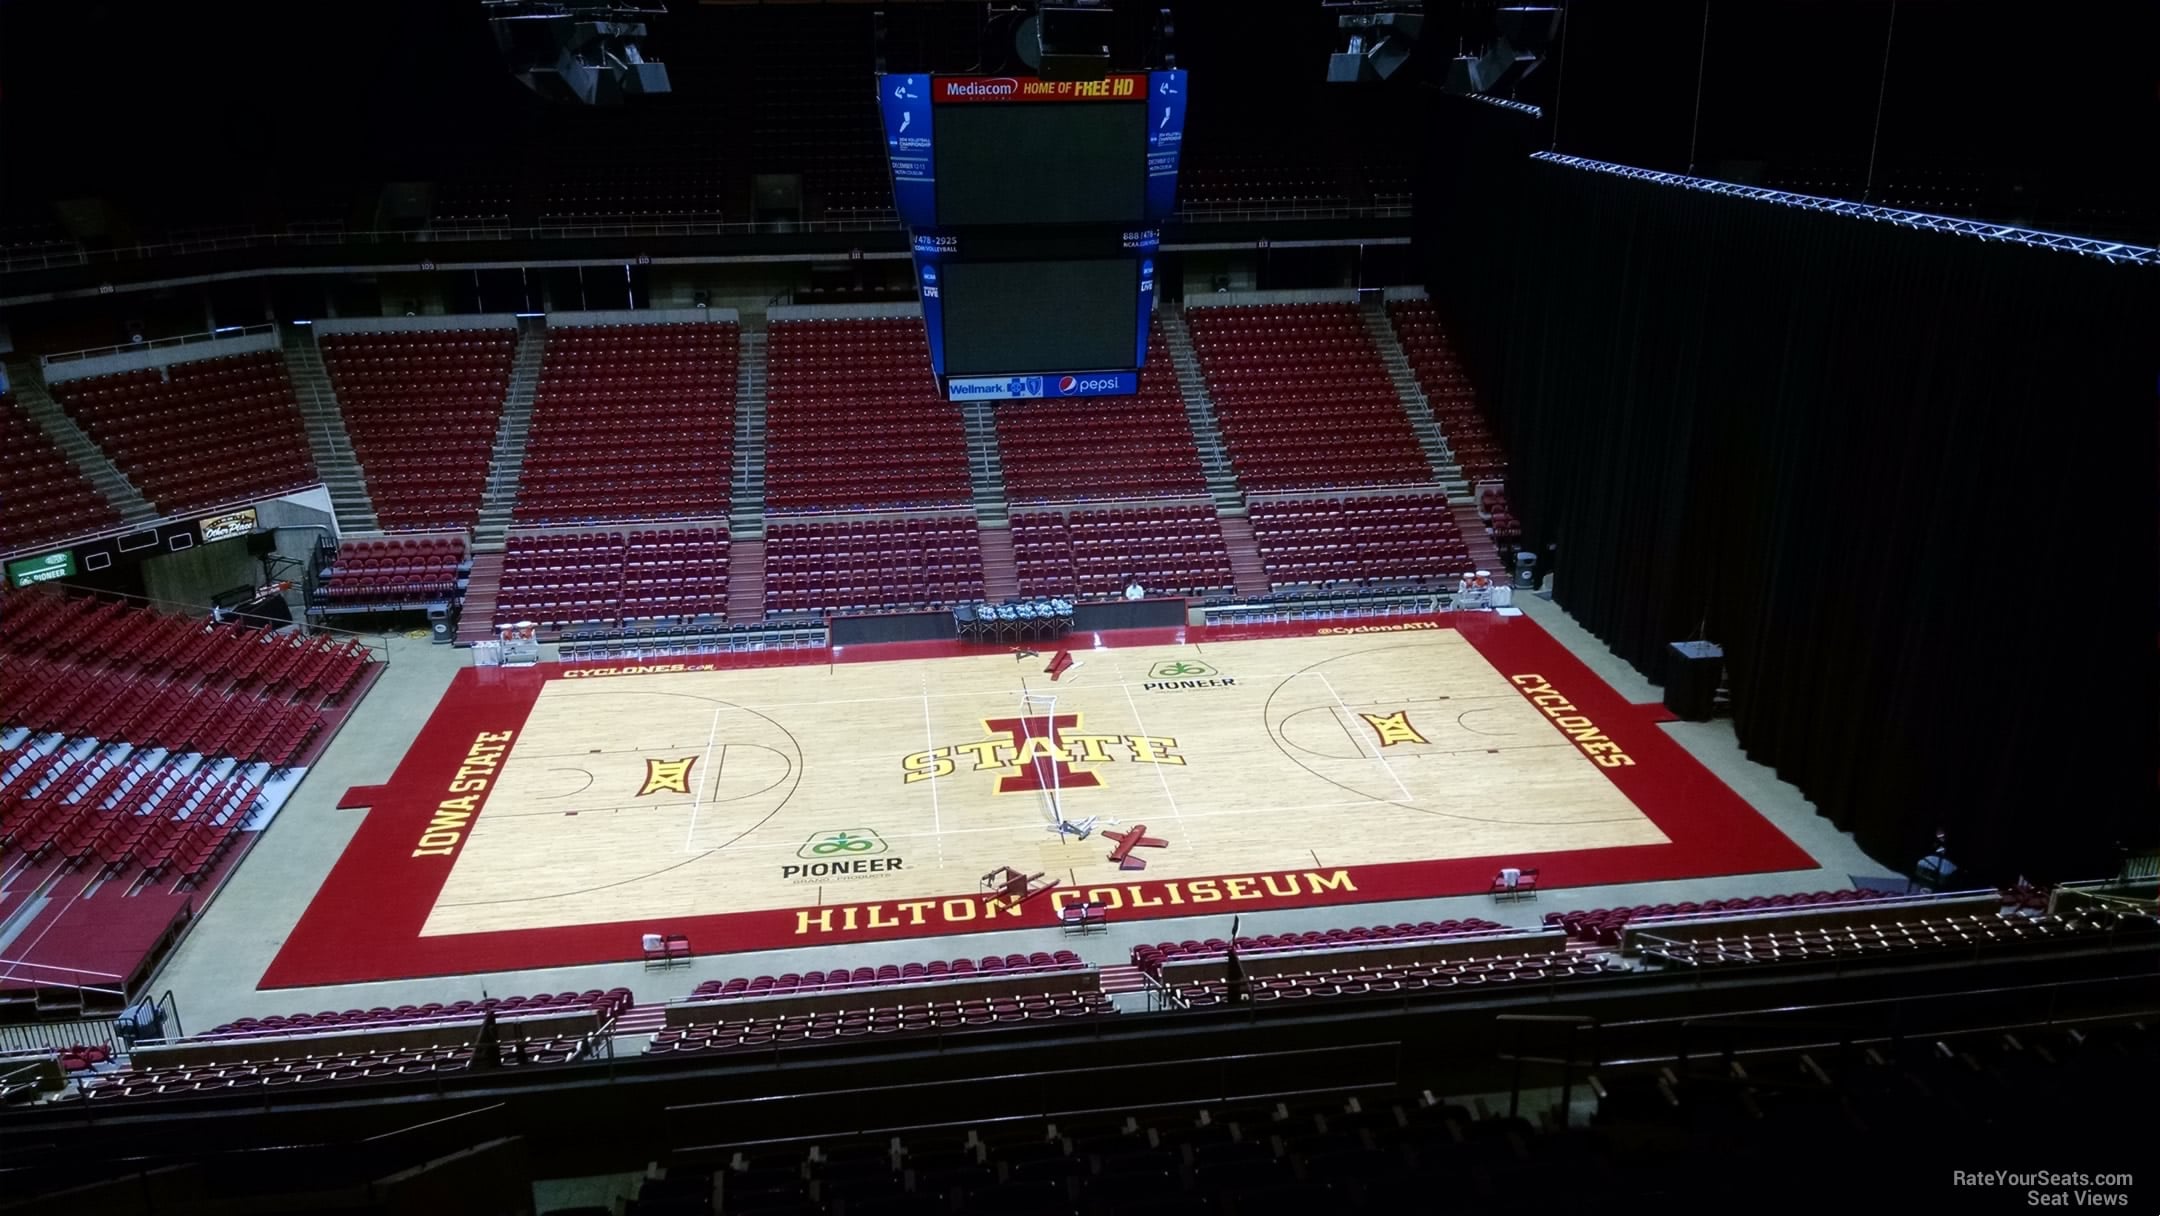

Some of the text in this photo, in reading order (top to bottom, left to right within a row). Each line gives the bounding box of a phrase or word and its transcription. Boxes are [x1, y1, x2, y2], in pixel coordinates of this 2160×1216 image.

[947, 82, 1012, 96] Mediacom
[1023, 78, 1134, 97] HOME OF FREE HD
[950, 383, 1003, 396] Wellmark
[1080, 377, 1119, 392] pepsi
[206, 526, 229, 538] Other
[228, 522, 253, 533] Place
[1318, 622, 1439, 634] @CycloneATH
[1144, 678, 1236, 691] PIONEER
[1511, 673, 1636, 768] CYCLONES
[902, 734, 1187, 784] STATE
[411, 730, 513, 858] IOWA STATE
[781, 858, 903, 879] PIONEER
[795, 870, 1358, 934] HILTON COLISEUM
